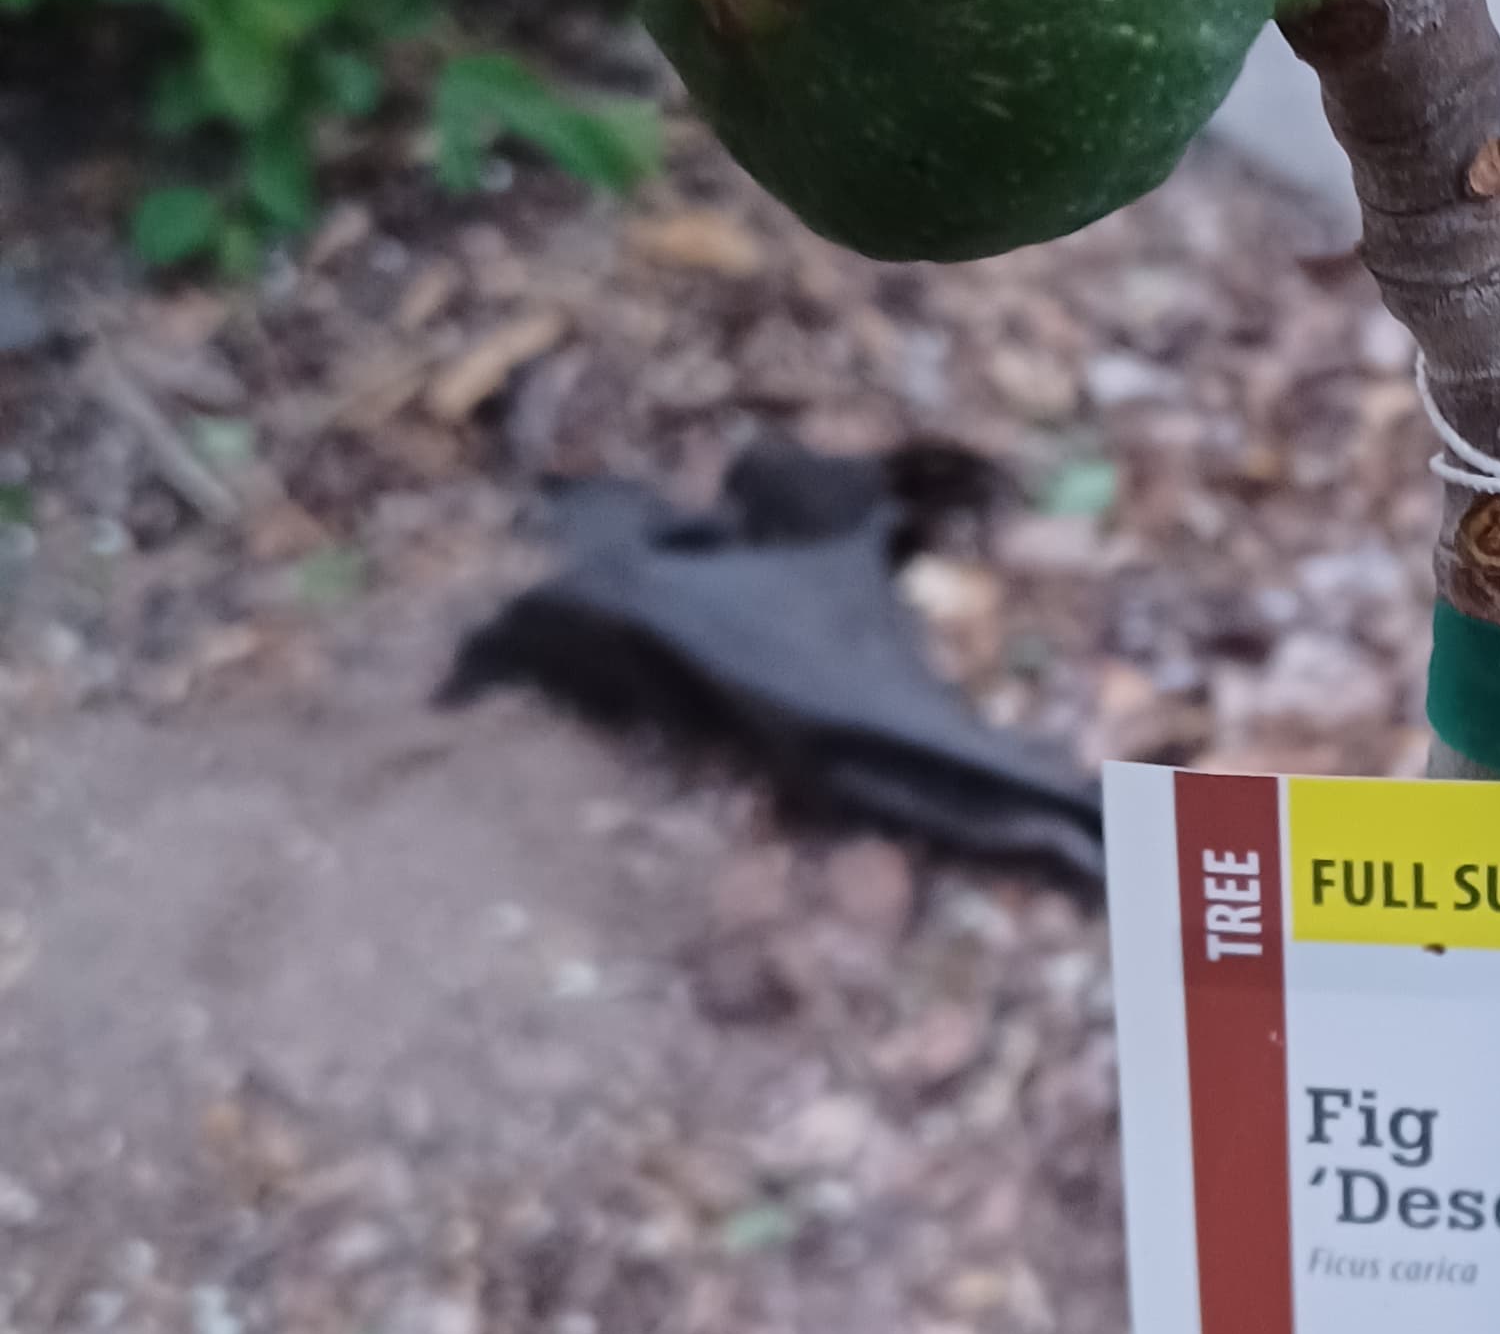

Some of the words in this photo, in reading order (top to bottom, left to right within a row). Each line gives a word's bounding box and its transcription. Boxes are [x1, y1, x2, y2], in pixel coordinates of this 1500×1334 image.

[1202, 848, 1263, 961] TREE
[1311, 858, 1438, 910] FULL
[1305, 1086, 1439, 1168] Fig
[1307, 1246, 1380, 1279] Ficus
[1391, 1254, 1479, 1286] carica
